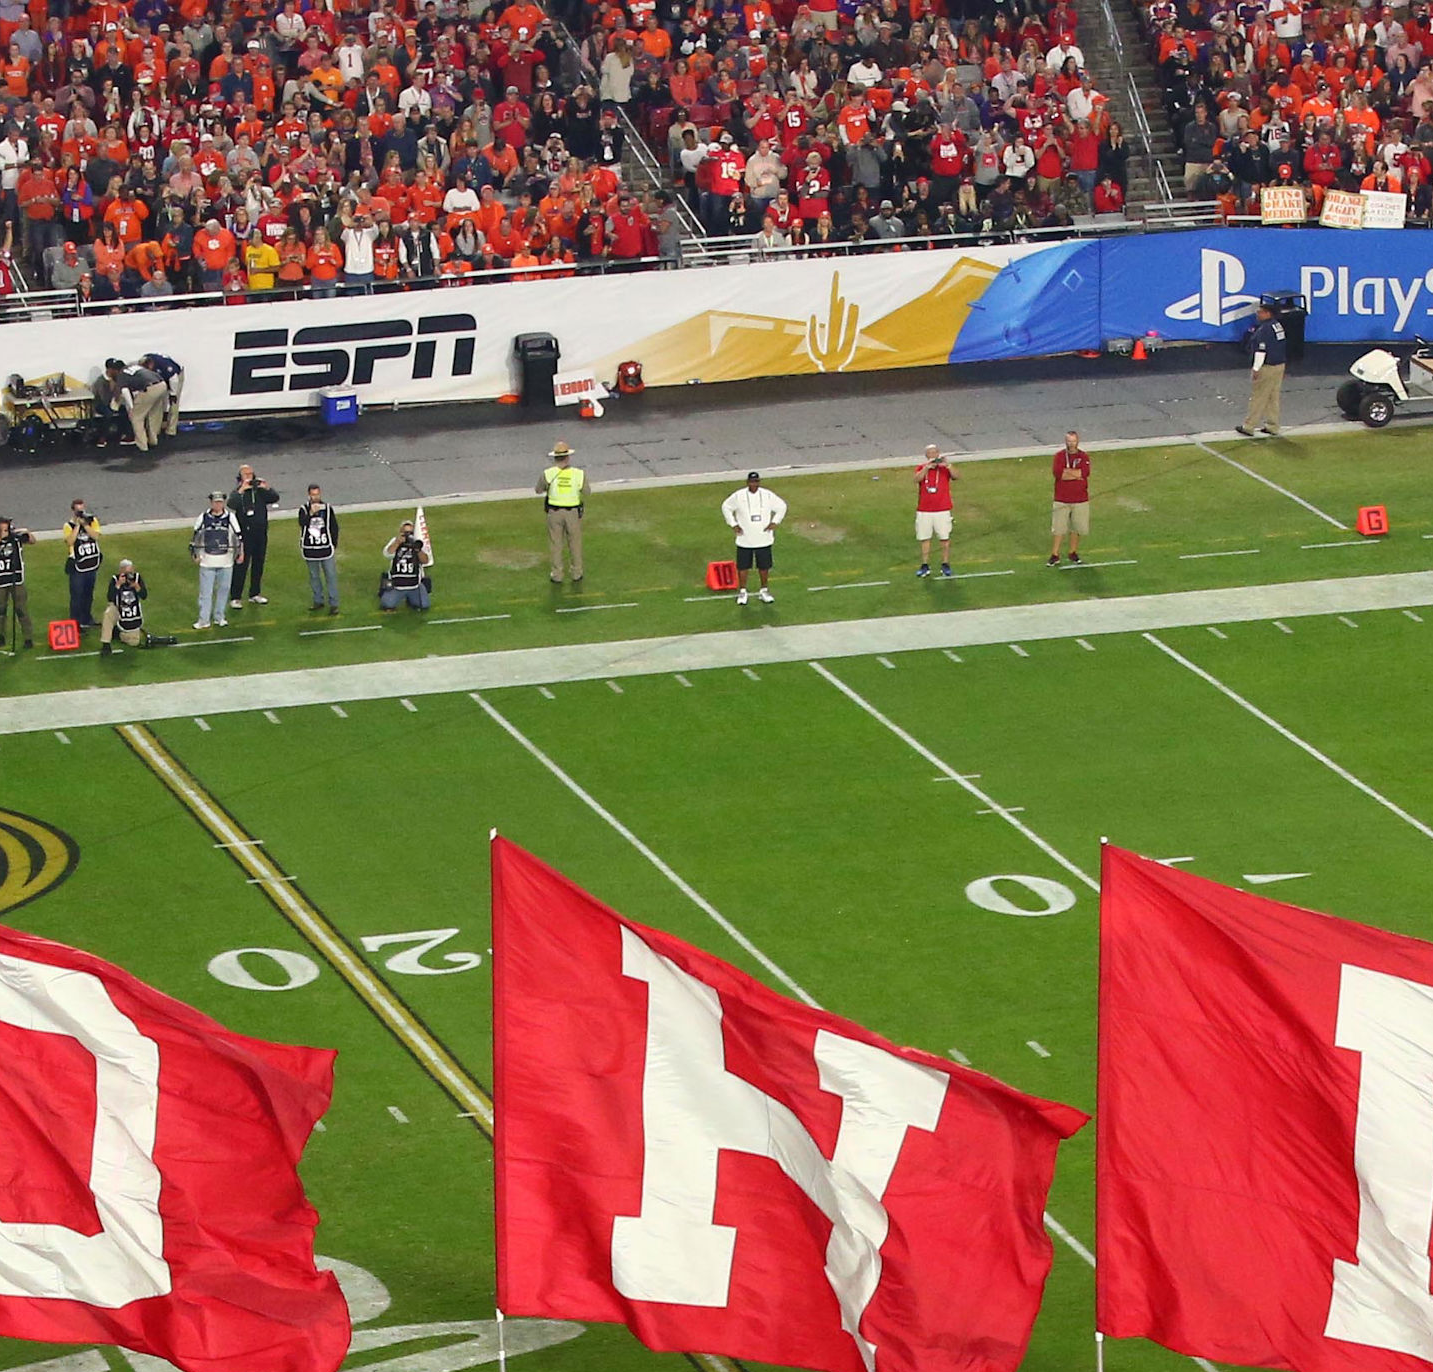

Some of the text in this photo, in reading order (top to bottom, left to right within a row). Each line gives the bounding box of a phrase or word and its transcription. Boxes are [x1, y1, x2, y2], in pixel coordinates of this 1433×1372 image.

[787, 111, 801, 128] 15
[230, 313, 476, 396] ESPN
[1367, 510, 1383, 531] G
[713, 563, 735, 587] 10
[54, 624, 76, 647] 20
